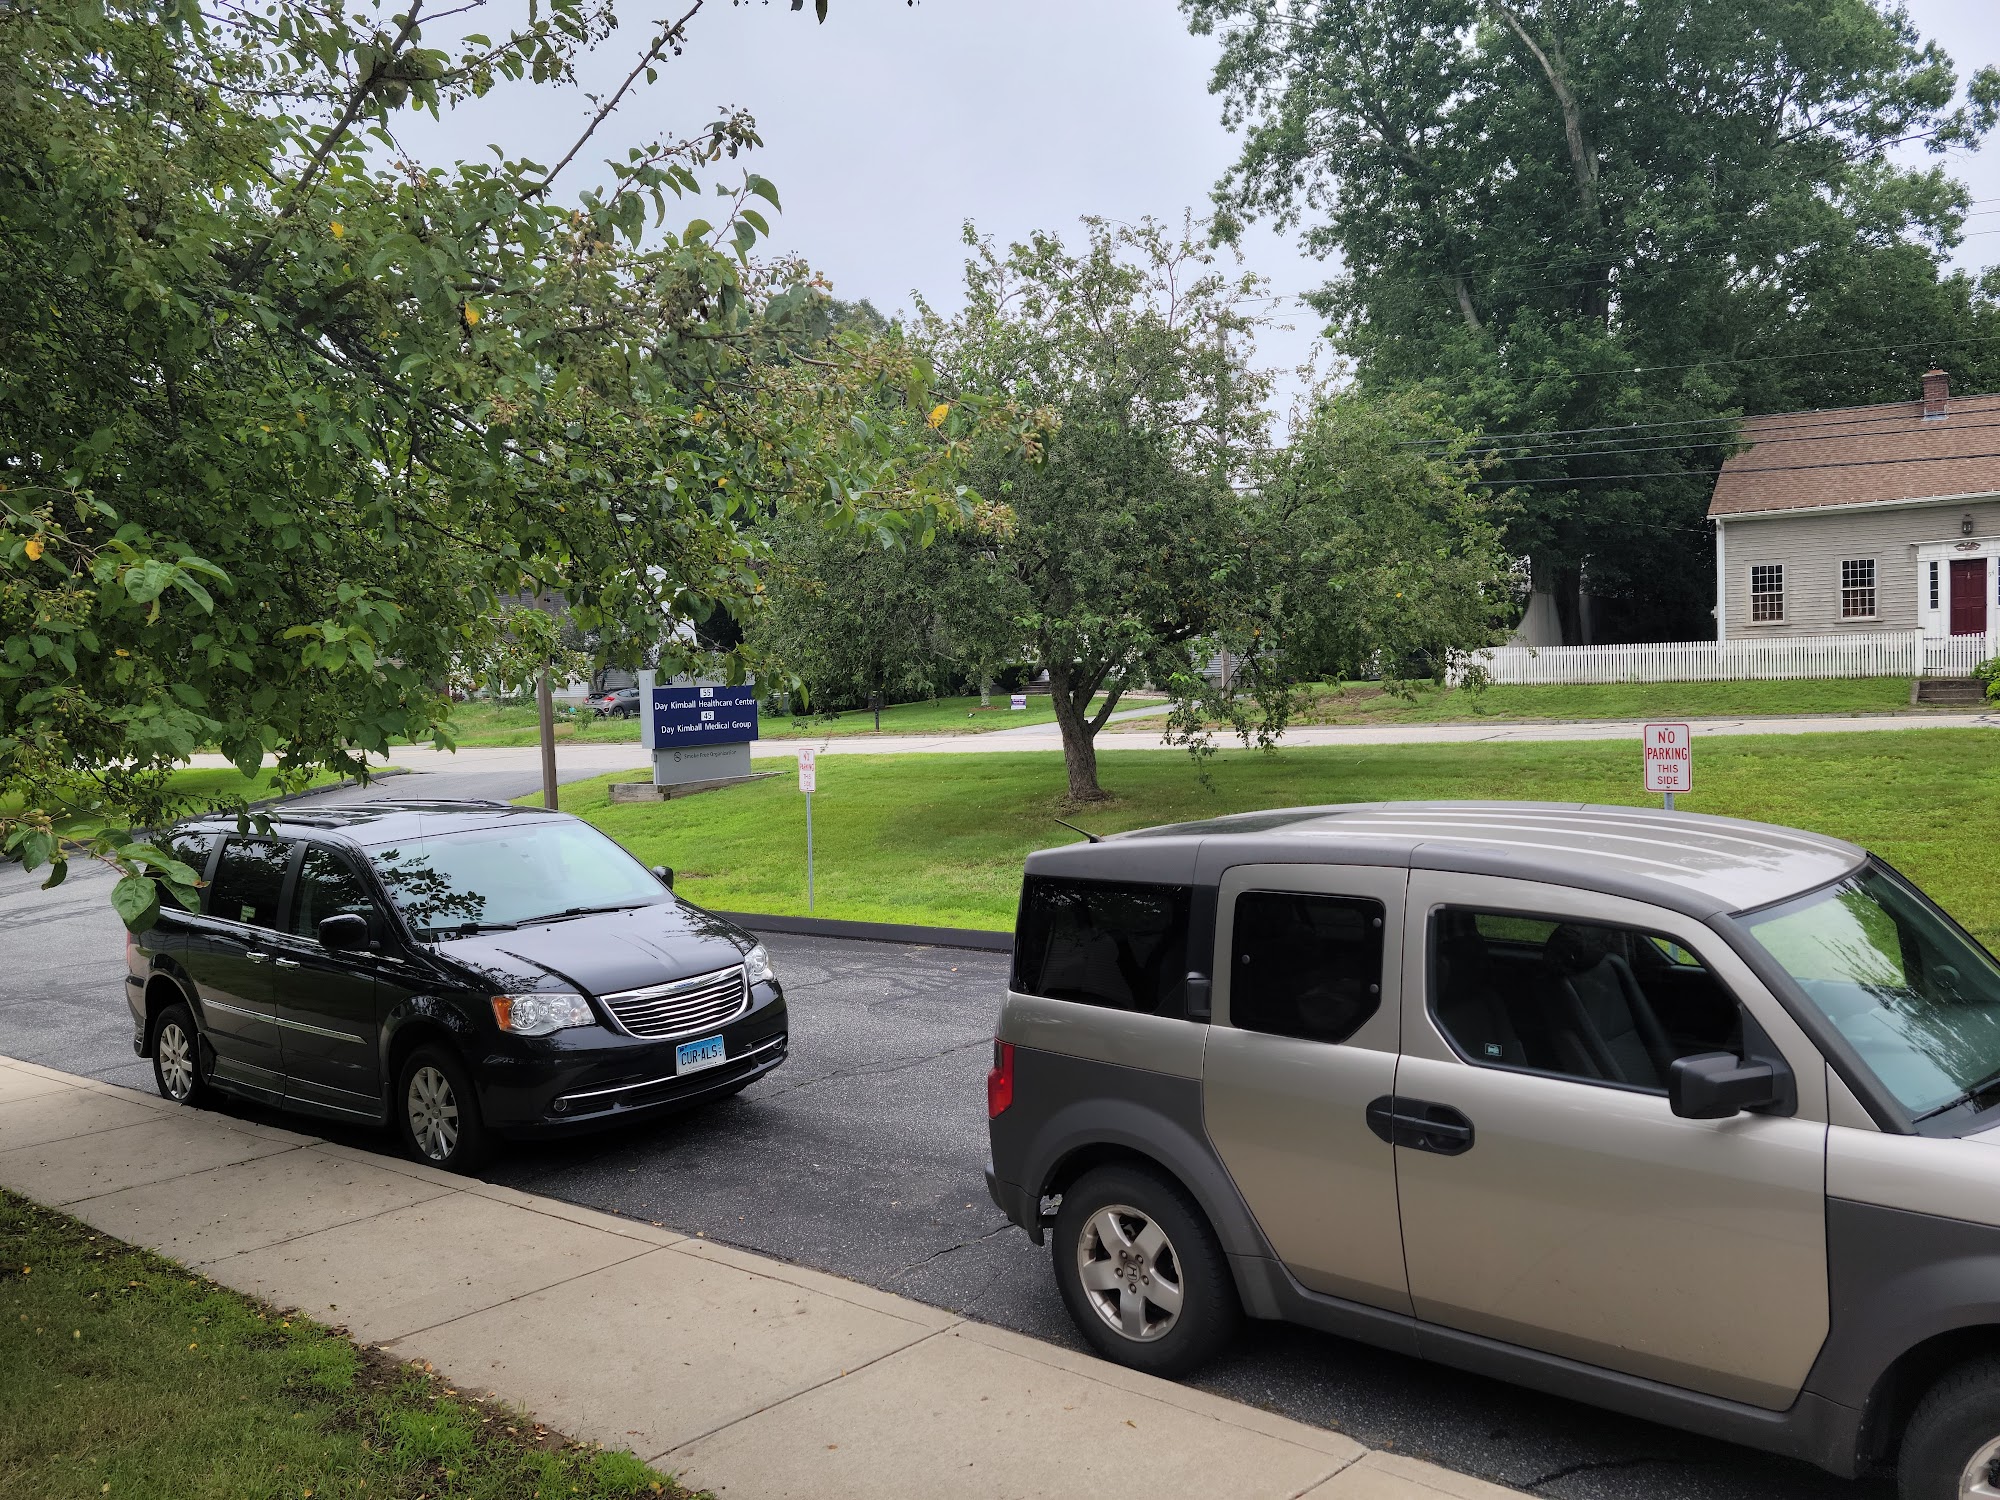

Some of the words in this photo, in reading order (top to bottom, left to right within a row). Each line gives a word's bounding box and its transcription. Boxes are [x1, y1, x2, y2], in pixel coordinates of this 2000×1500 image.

[702, 688, 711, 697] 55
[654, 702, 668, 712] Day
[670, 700, 696, 709] Kimball
[699, 699, 733, 708] Healthcare
[735, 698, 756, 706] Center
[703, 712, 712, 720] 45
[661, 725, 675, 735] Day
[677, 723, 702, 733] Kimball
[704, 721, 730, 731] Medical
[732, 720, 752, 729] Group
[1658, 731, 1675, 744] NO
[1647, 747, 1688, 760] PARKING
[1657, 764, 1679, 773] THIS
[1657, 776, 1679, 785] SIDE
